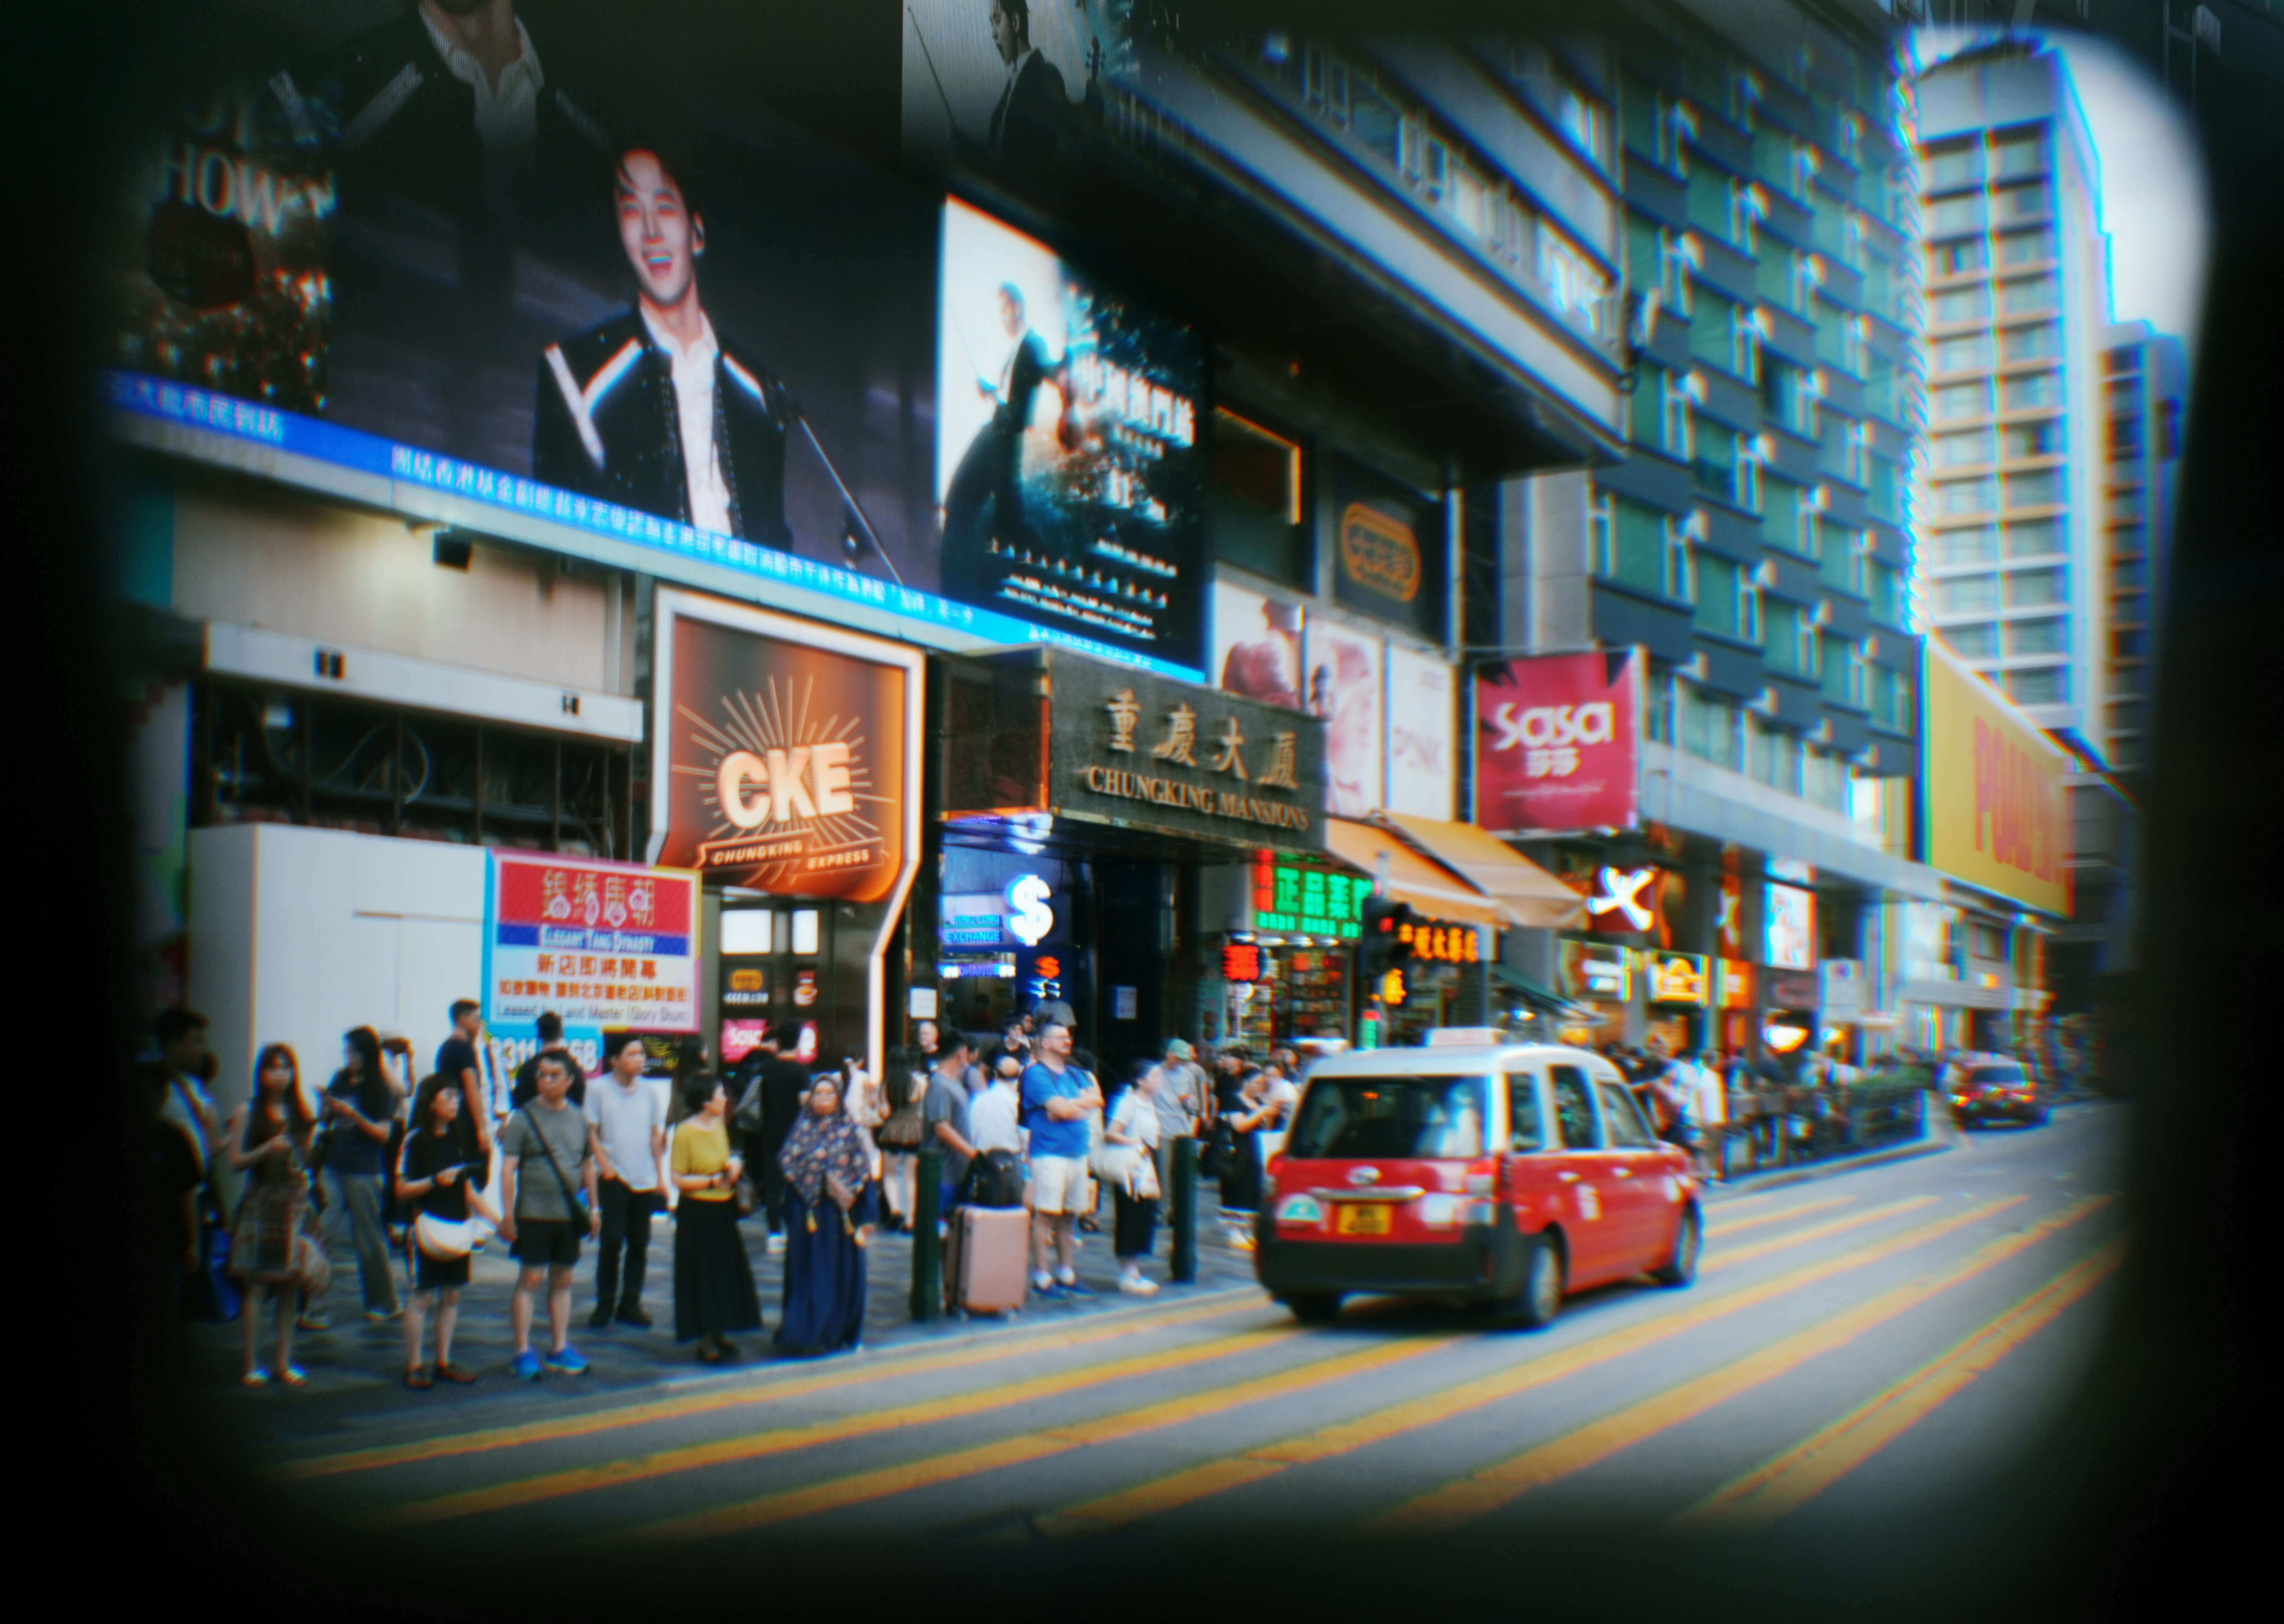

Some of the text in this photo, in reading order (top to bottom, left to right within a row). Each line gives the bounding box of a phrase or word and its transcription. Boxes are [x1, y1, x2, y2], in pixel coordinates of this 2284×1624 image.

[1492, 701, 1615, 752] Sasa
[718, 741, 855, 831] CKE
[1087, 765, 1310, 831] CHUNGKING MANSIONS
[712, 840, 870, 870] CHUNGKING EXPRESS
[953, 914, 999, 923] HONG KONG
[946, 930, 1000, 941] EXCHANGE
[537, 953, 657, 979] 新店即將開幕
[498, 1001, 538, 1018] Leased
[560, 1003, 585, 1018] Land
[589, 1004, 623, 1019] Master
